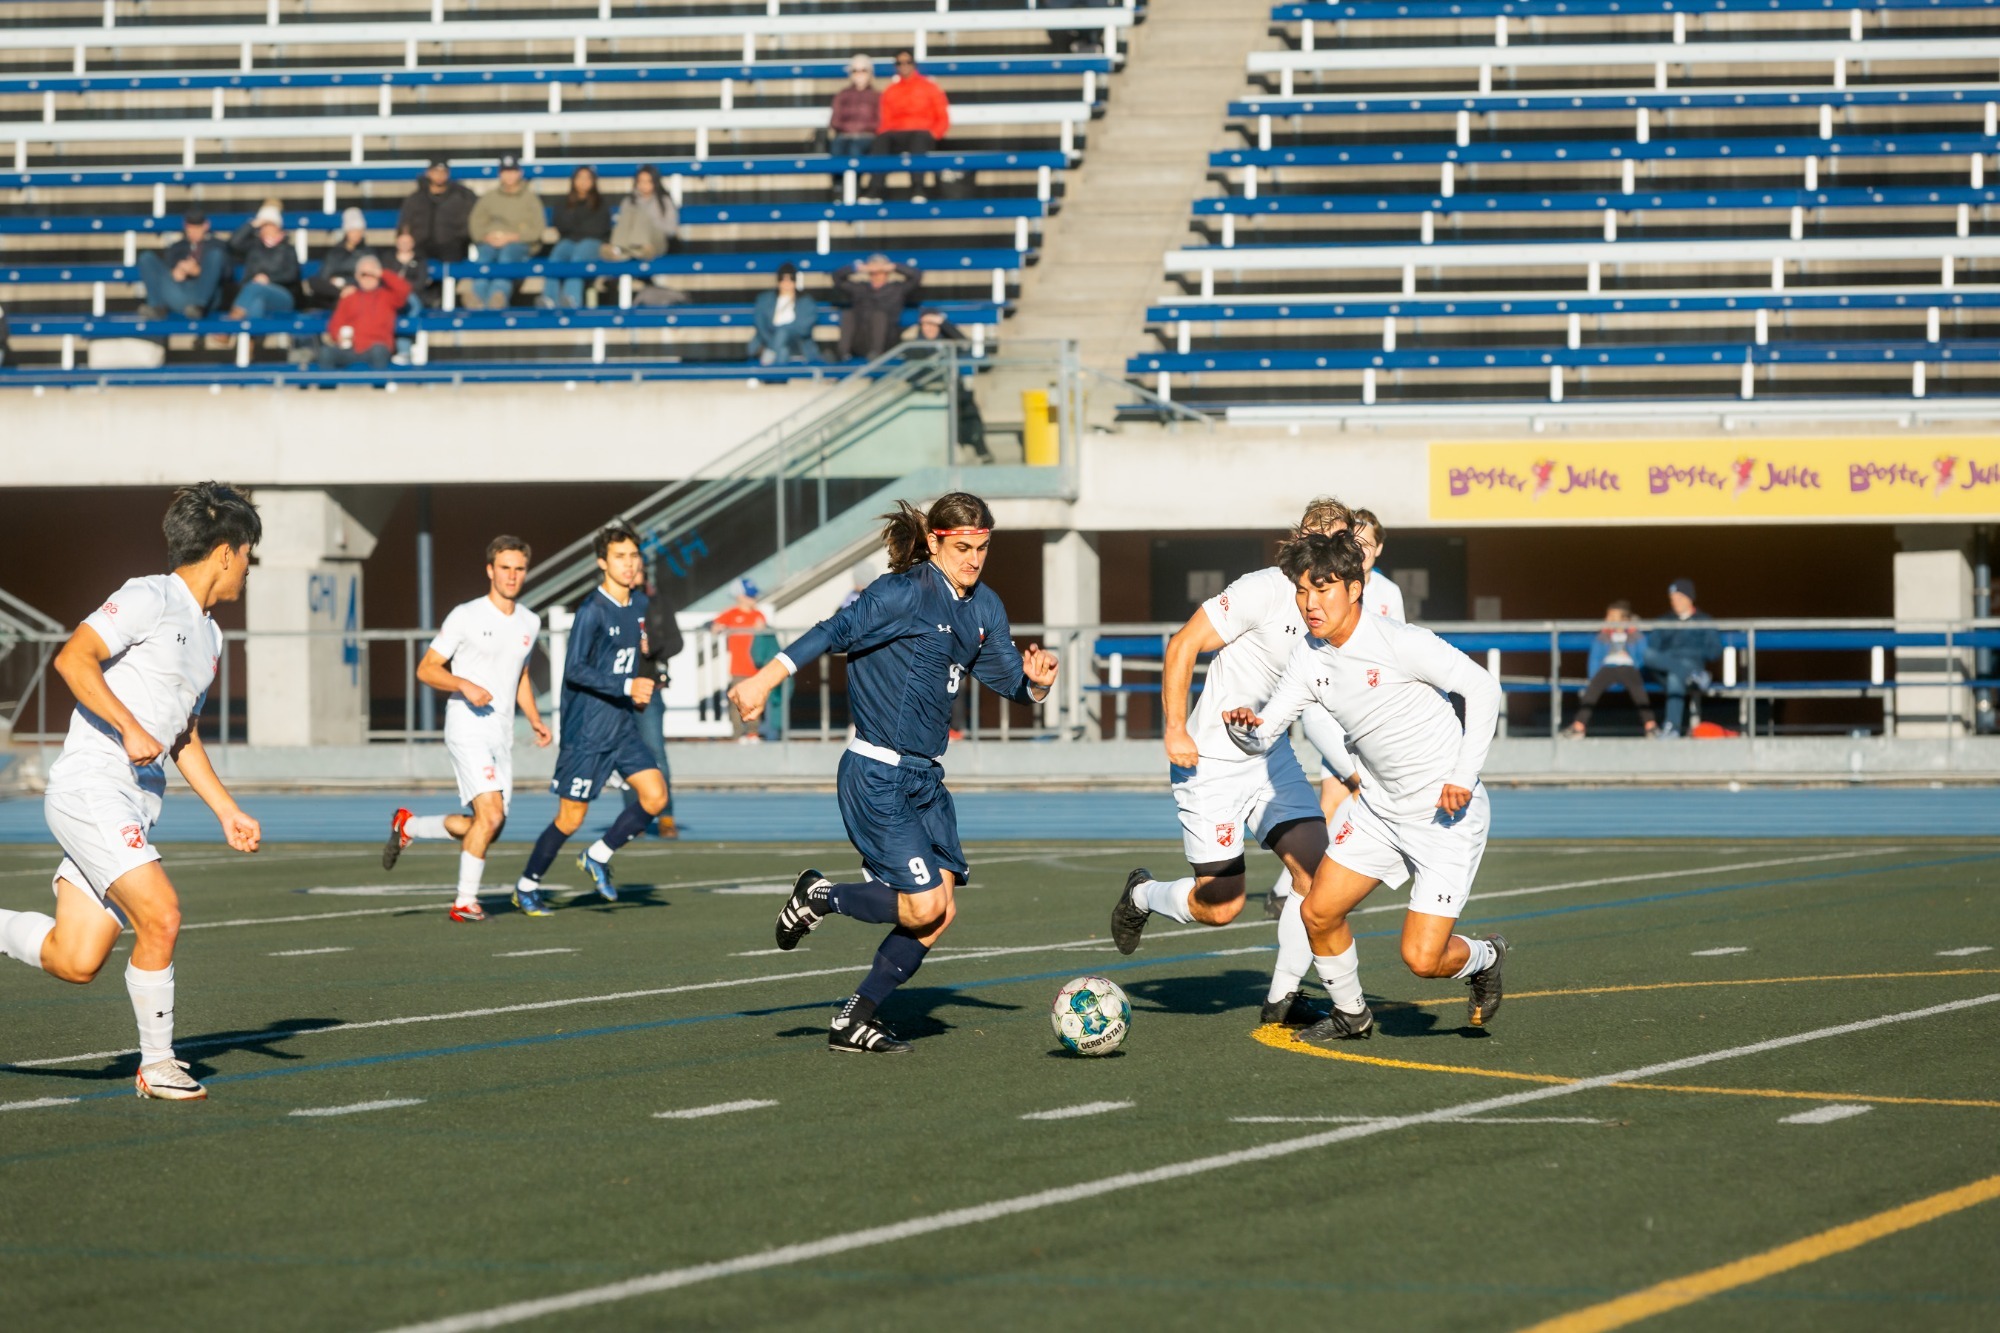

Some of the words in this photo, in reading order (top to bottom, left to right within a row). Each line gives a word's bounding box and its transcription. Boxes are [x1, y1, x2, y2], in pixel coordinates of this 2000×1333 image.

[1449, 465, 1527, 496] Booster
[1558, 464, 1621, 494] Juice
[1649, 464, 1727, 494] Booster
[1759, 462, 1821, 491] Juice
[1849, 462, 1928, 492] Booster
[1960, 460, 2000, 489] Jui
[613, 647, 636, 674] 27
[570, 777, 593, 798] 27
[908, 856, 931, 886] 9
[1080, 1022, 1124, 1050] DERBYSTAR
